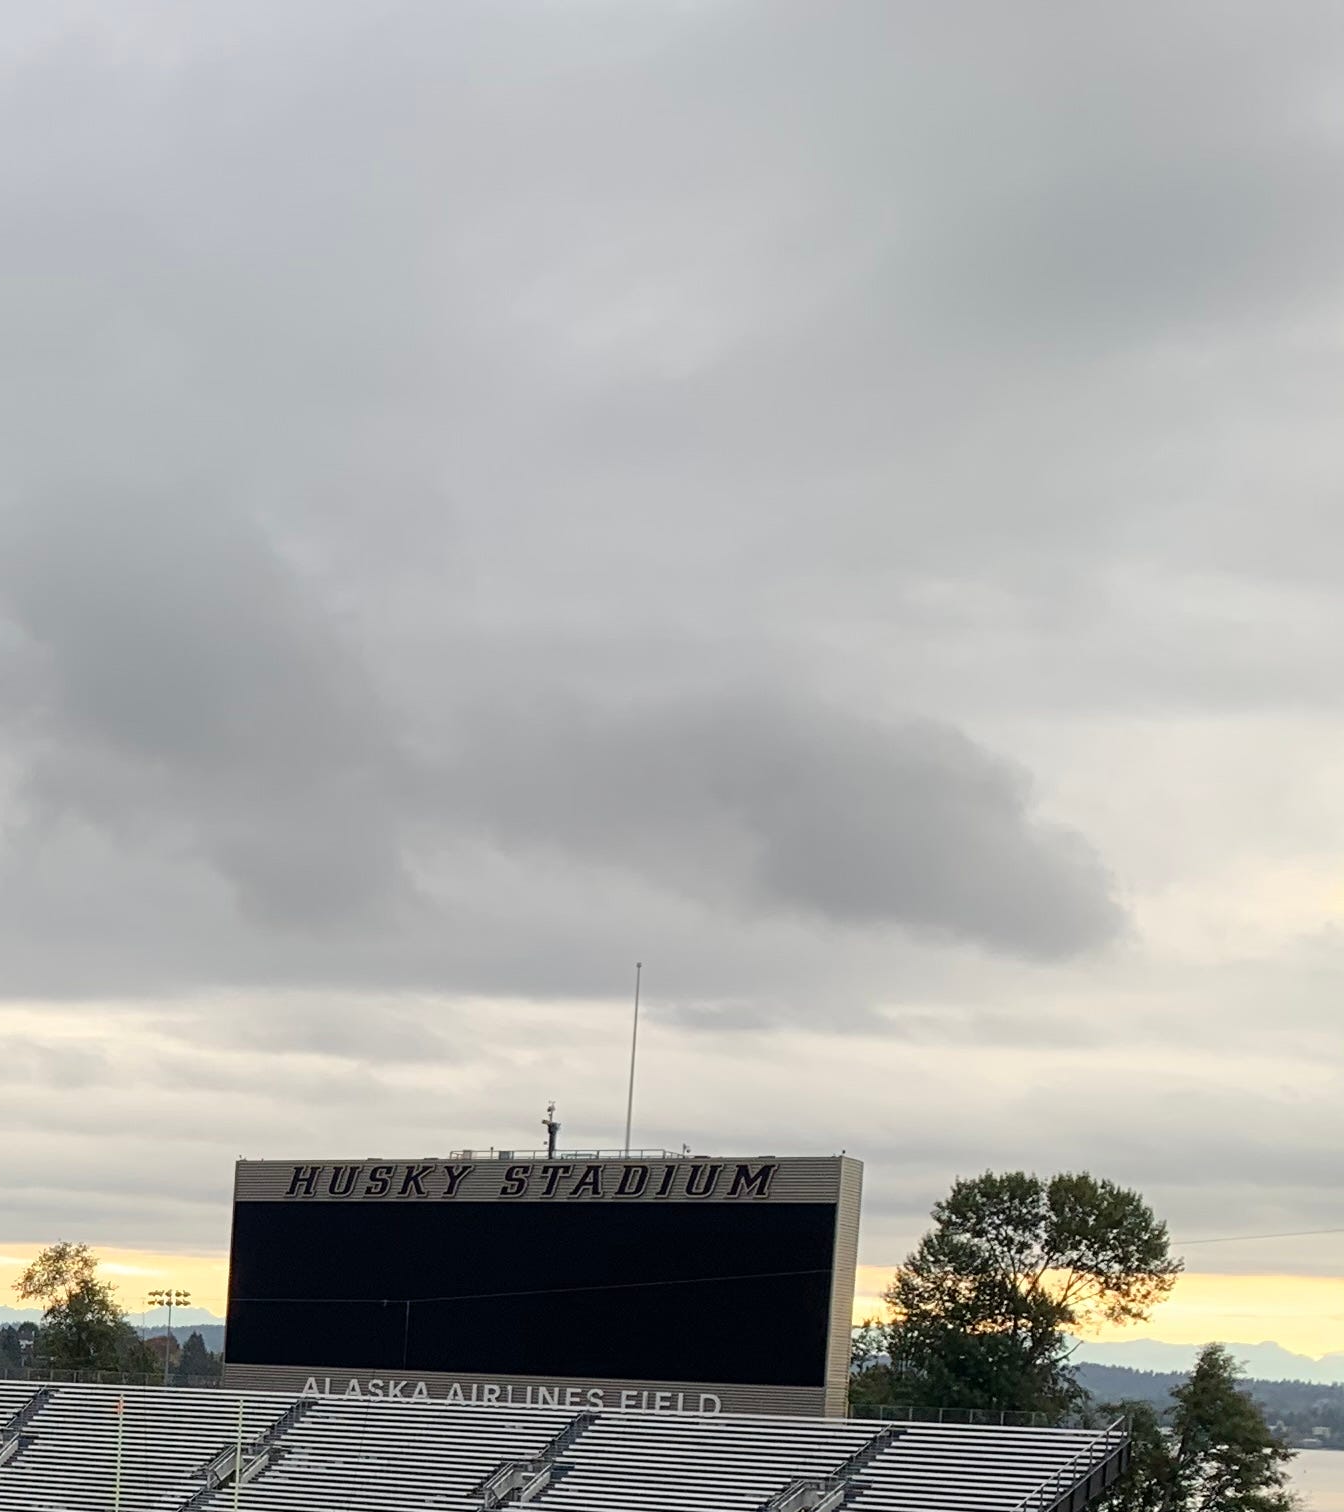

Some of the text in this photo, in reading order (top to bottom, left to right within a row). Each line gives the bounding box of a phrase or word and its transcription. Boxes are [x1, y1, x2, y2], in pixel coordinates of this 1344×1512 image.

[284, 1163, 779, 1199] HUSKY STADIUM
[302, 1376, 722, 1416] ALASKA AIRLINES FIELD
